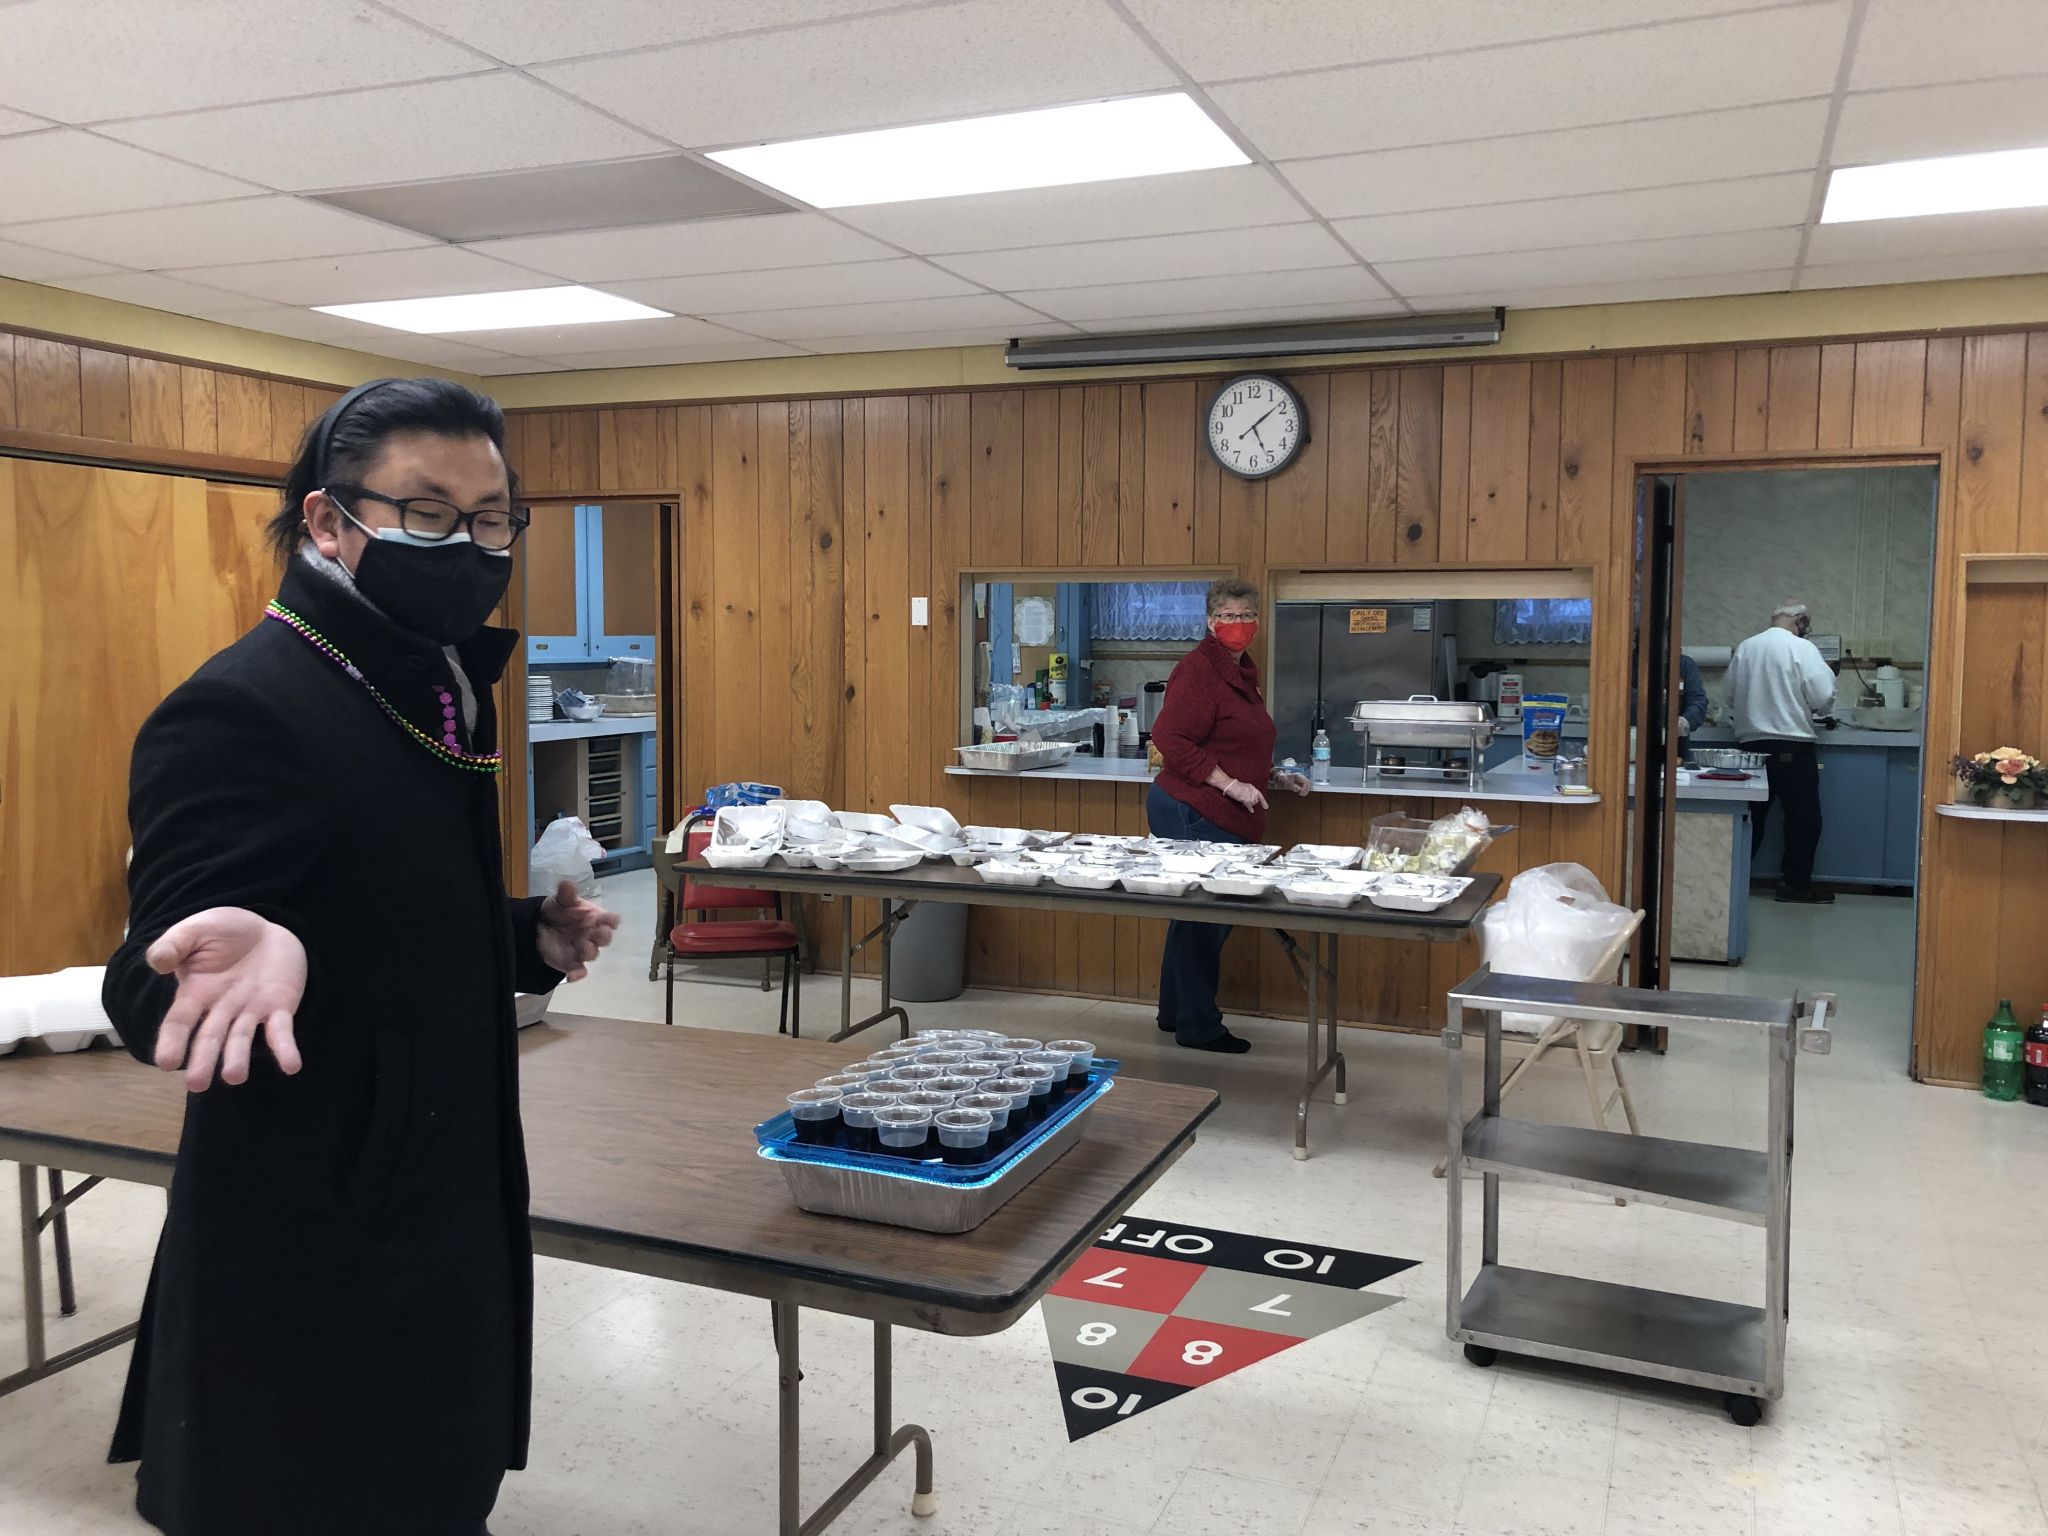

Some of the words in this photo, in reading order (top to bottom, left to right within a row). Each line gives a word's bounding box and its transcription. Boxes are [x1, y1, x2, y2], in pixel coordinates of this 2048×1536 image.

[1233, 391, 1243, 405] 11
[1247, 385, 1261, 399] 12
[1268, 389, 1274, 402] 1
[1222, 404, 1234, 418] 10
[1278, 402, 1287, 415] 2
[1215, 422, 1223, 434] 9
[1285, 419, 1294, 433] 3
[1220, 438, 1229, 452] 8
[1278, 437, 1287, 450] 4
[1233, 450, 1241, 464] 7
[1249, 455, 1258, 468] 6
[1266, 450, 1275, 463] 5
[1100, 1224, 1213, 1253] OFF
[1084, 1267, 1127, 1288] 7
[1248, 1293, 1291, 1316] 7
[1076, 1322, 1117, 1346] 8
[1181, 1340, 1223, 1365] 8
